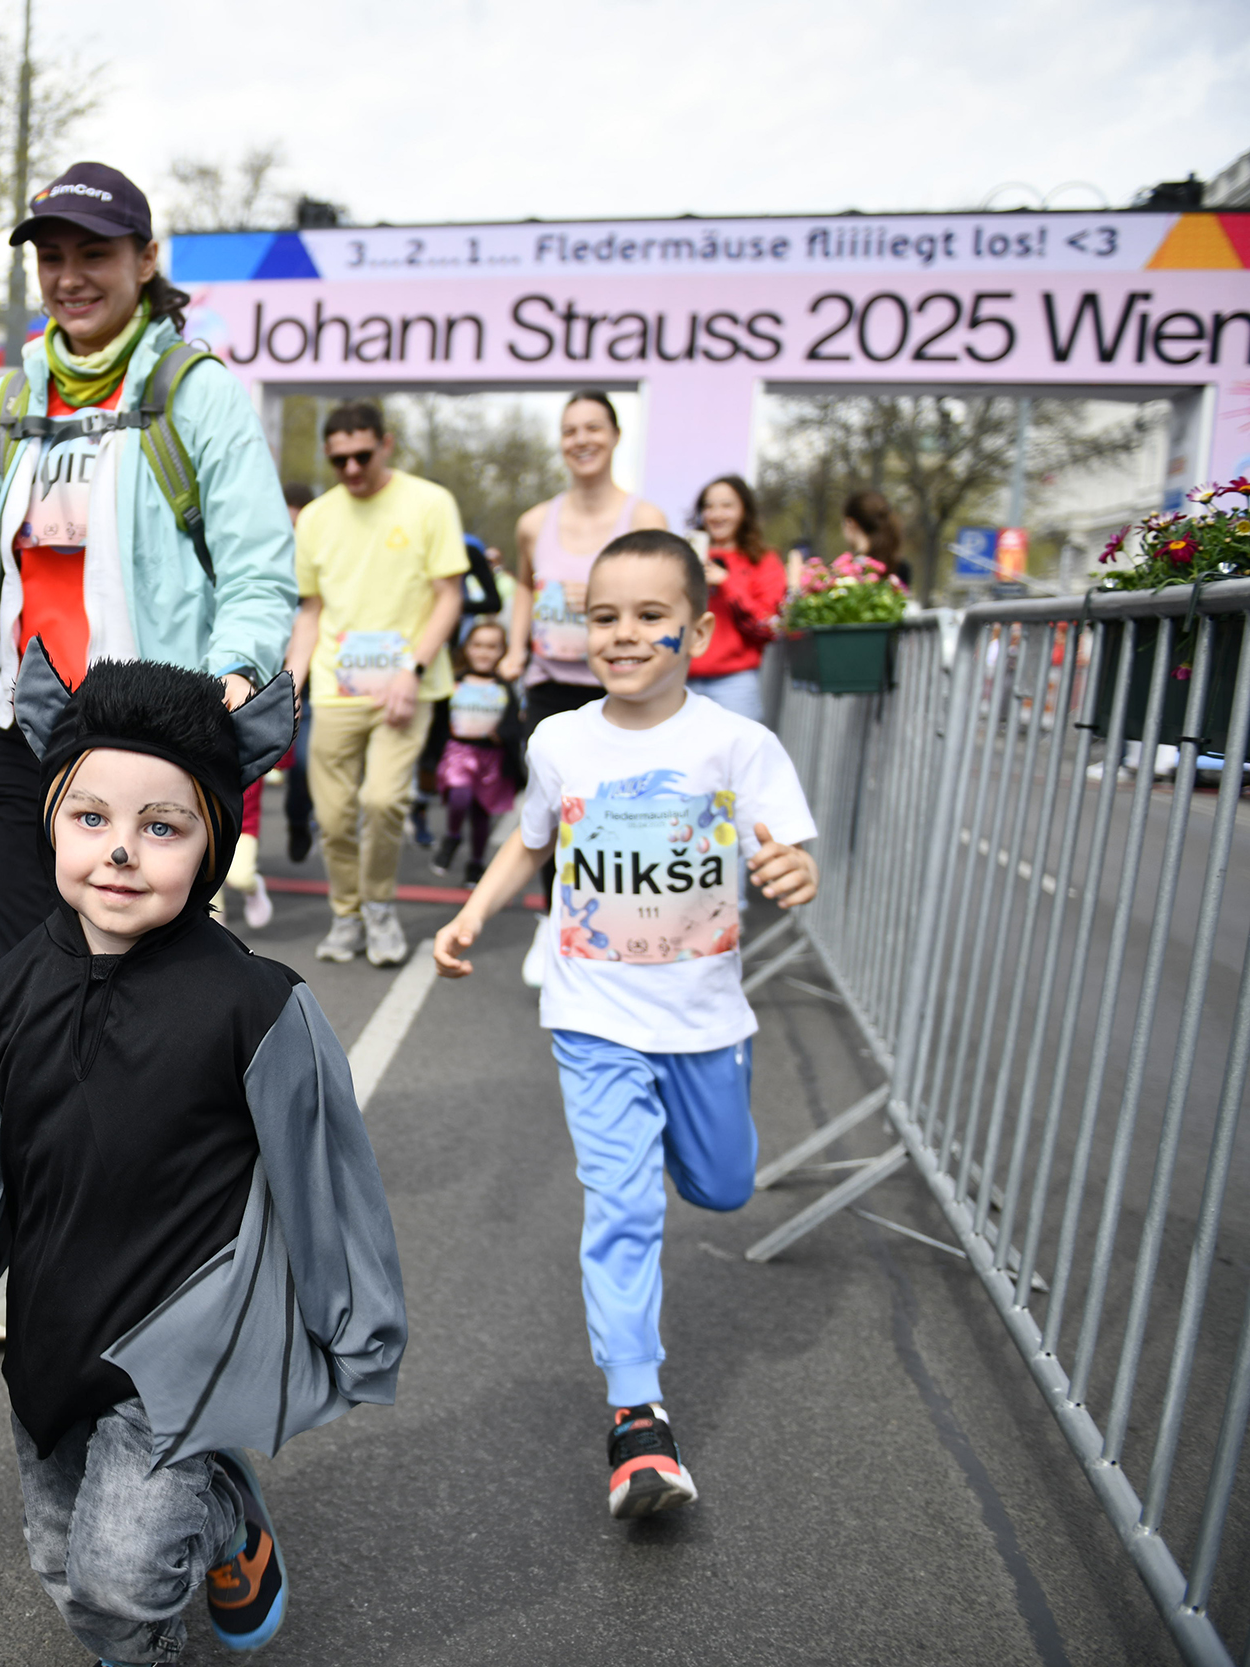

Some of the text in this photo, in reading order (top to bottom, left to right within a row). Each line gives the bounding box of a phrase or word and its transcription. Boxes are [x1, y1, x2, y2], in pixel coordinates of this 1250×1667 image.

[534, 229, 790, 263] Fledermäuse
[972, 225, 1047, 259] los!
[1065, 225, 1118, 258] <3
[228, 289, 1250, 367] Johann Strauss 2025 Wien
[339, 651, 403, 671] GUIDE
[572, 847, 724, 895] Nikša
[637, 906, 659, 919] 111
